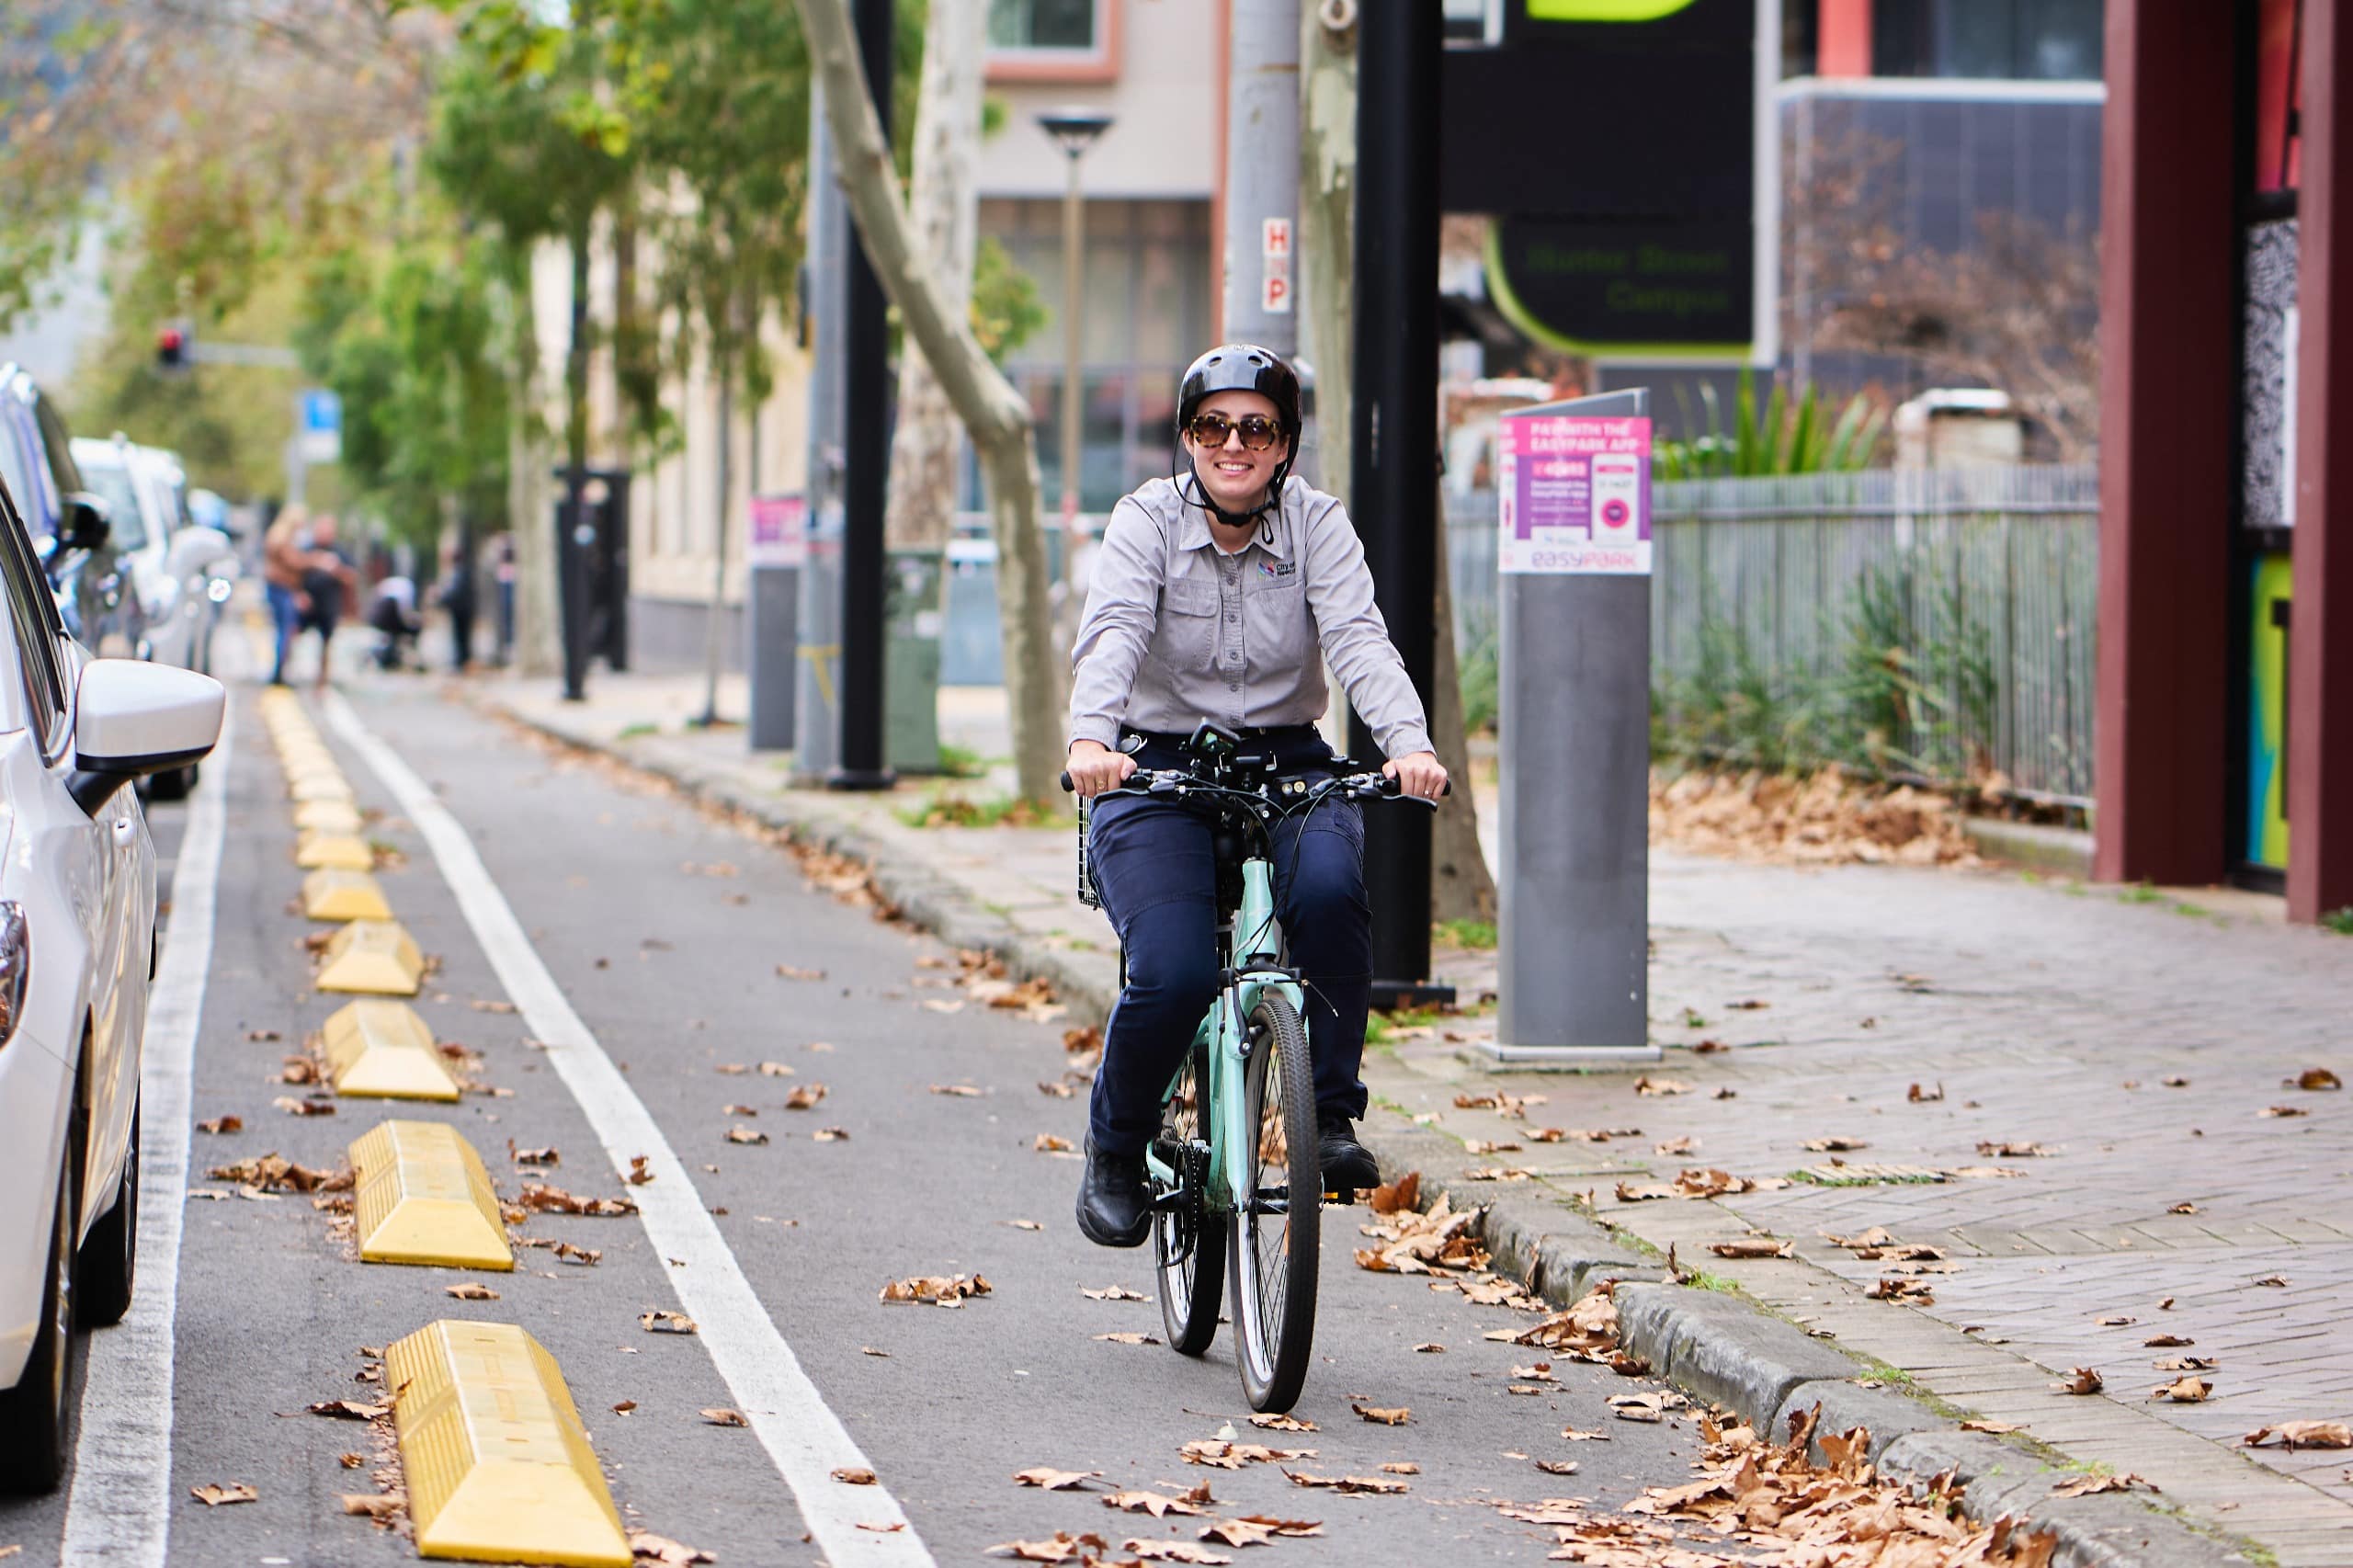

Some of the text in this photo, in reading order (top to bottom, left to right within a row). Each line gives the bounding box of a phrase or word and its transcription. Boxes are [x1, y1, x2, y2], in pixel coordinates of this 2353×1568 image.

[1605, 280, 1729, 319] Campus
[1608, 437, 1639, 451] APP
[1276, 563, 1289, 572] City
